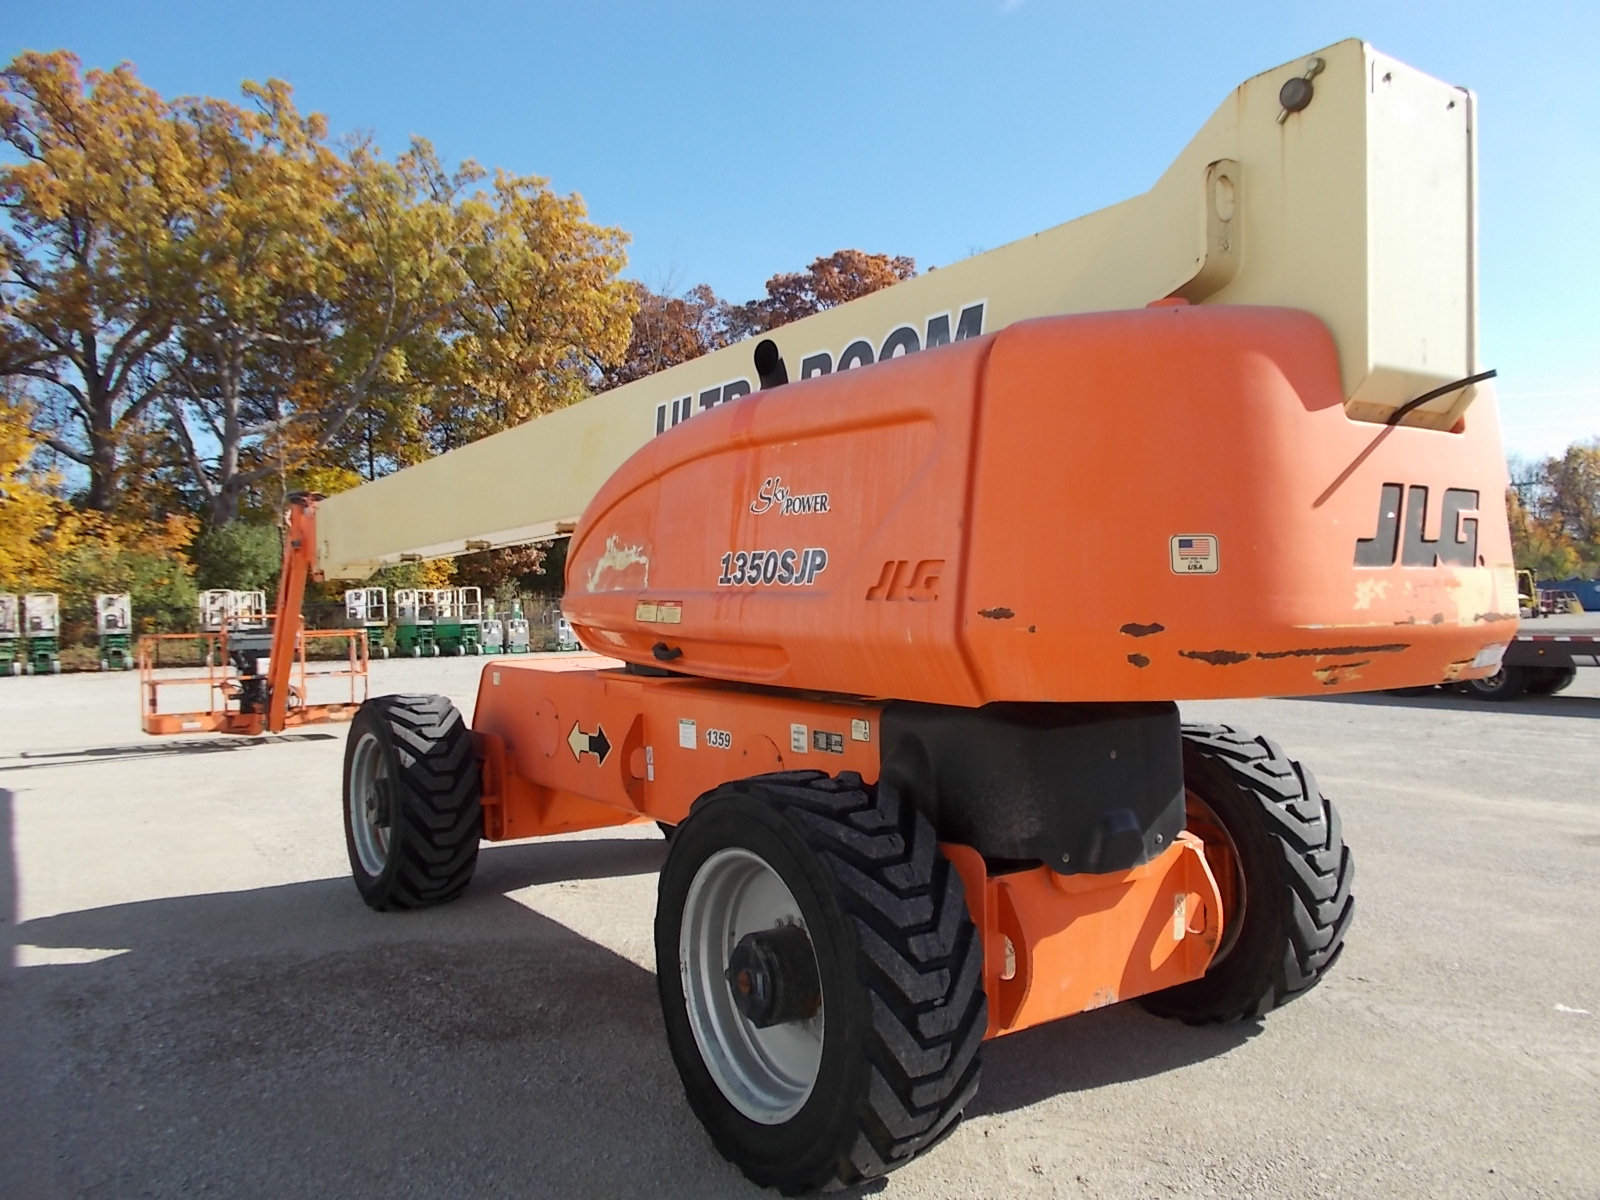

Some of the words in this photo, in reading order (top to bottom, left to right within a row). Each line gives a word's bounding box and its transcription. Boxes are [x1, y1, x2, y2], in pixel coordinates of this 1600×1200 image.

[750, 476, 790, 515] Sky
[785, 494, 829, 515] POWER
[1353, 482, 1480, 568] JLG
[718, 548, 828, 587] 1350SJP
[866, 559, 945, 601] JLG
[706, 728, 732, 749] 1359
